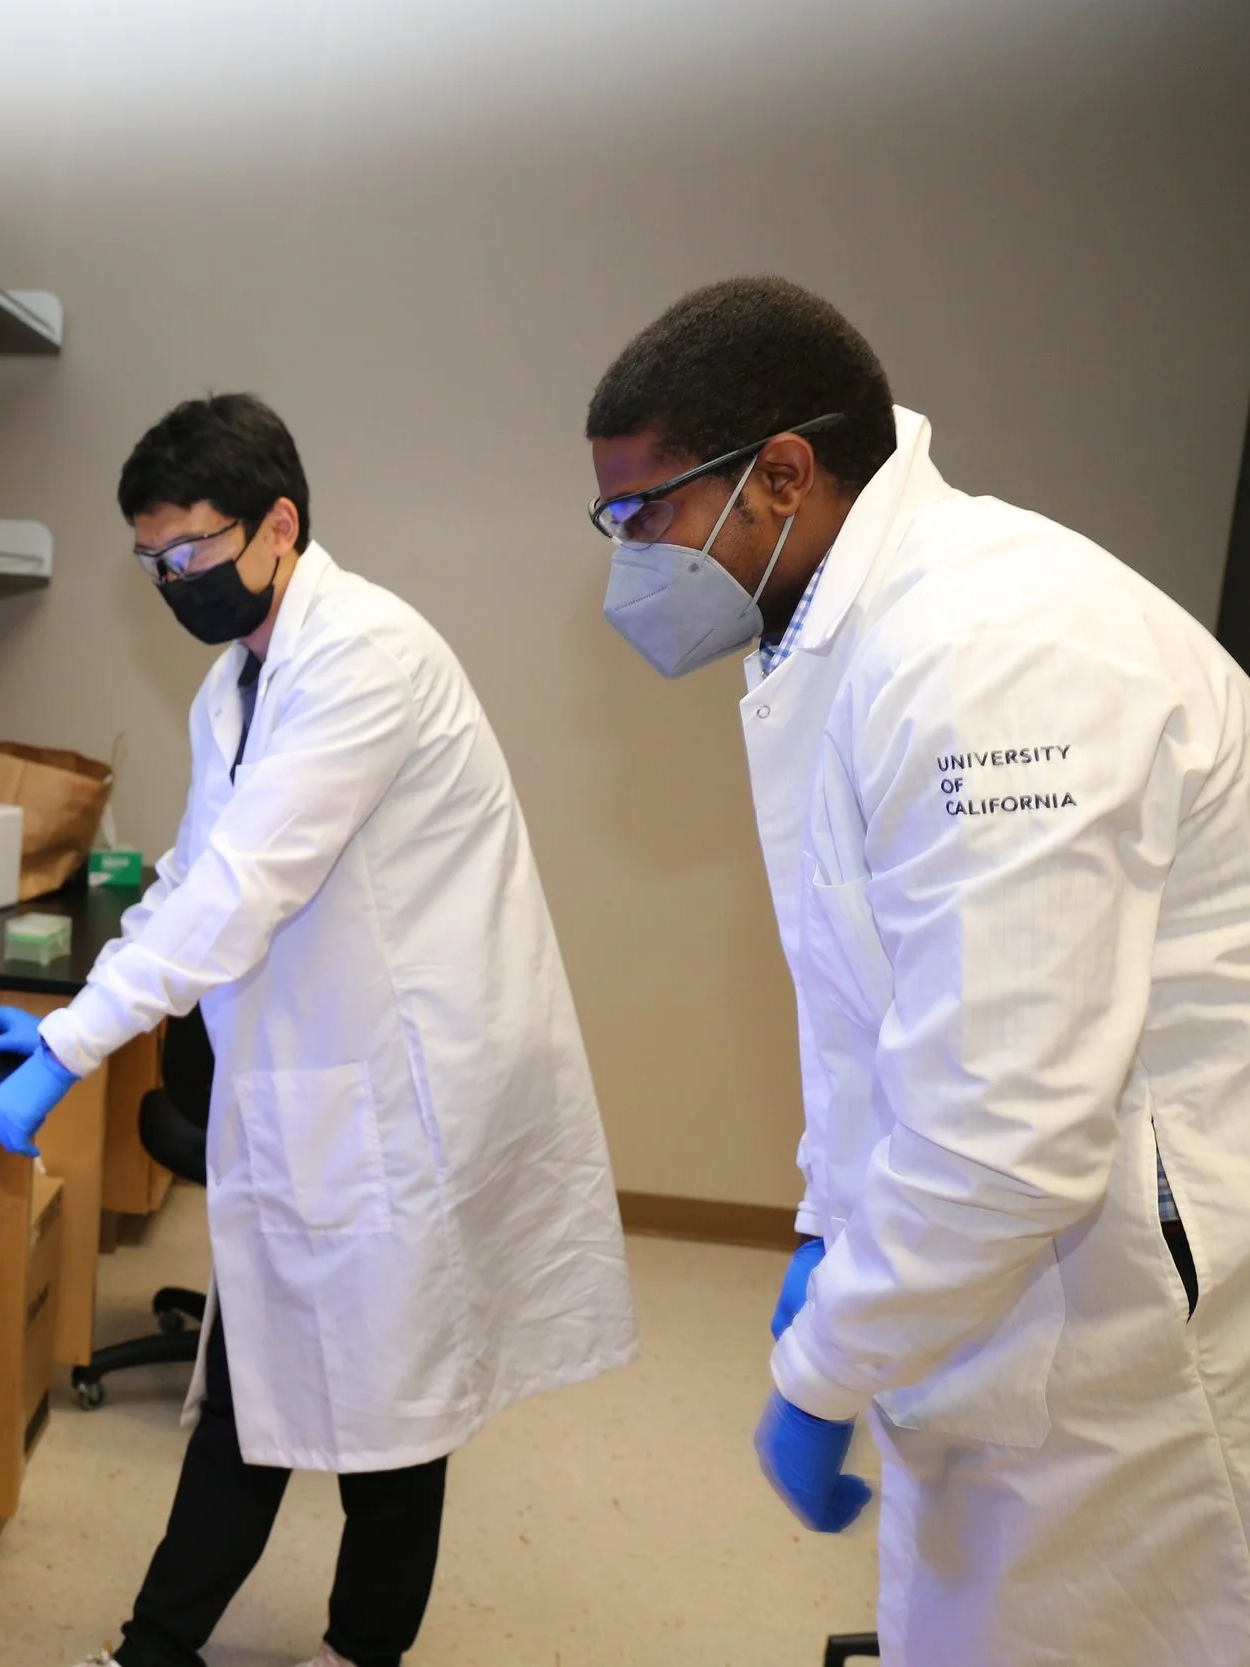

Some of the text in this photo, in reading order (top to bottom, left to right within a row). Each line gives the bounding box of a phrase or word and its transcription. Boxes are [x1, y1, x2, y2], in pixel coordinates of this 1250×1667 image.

[937, 745, 1071, 772] UNIVERSITY
[941, 777, 964, 794] OF
[946, 792, 1077, 816] CALIFORNIA
